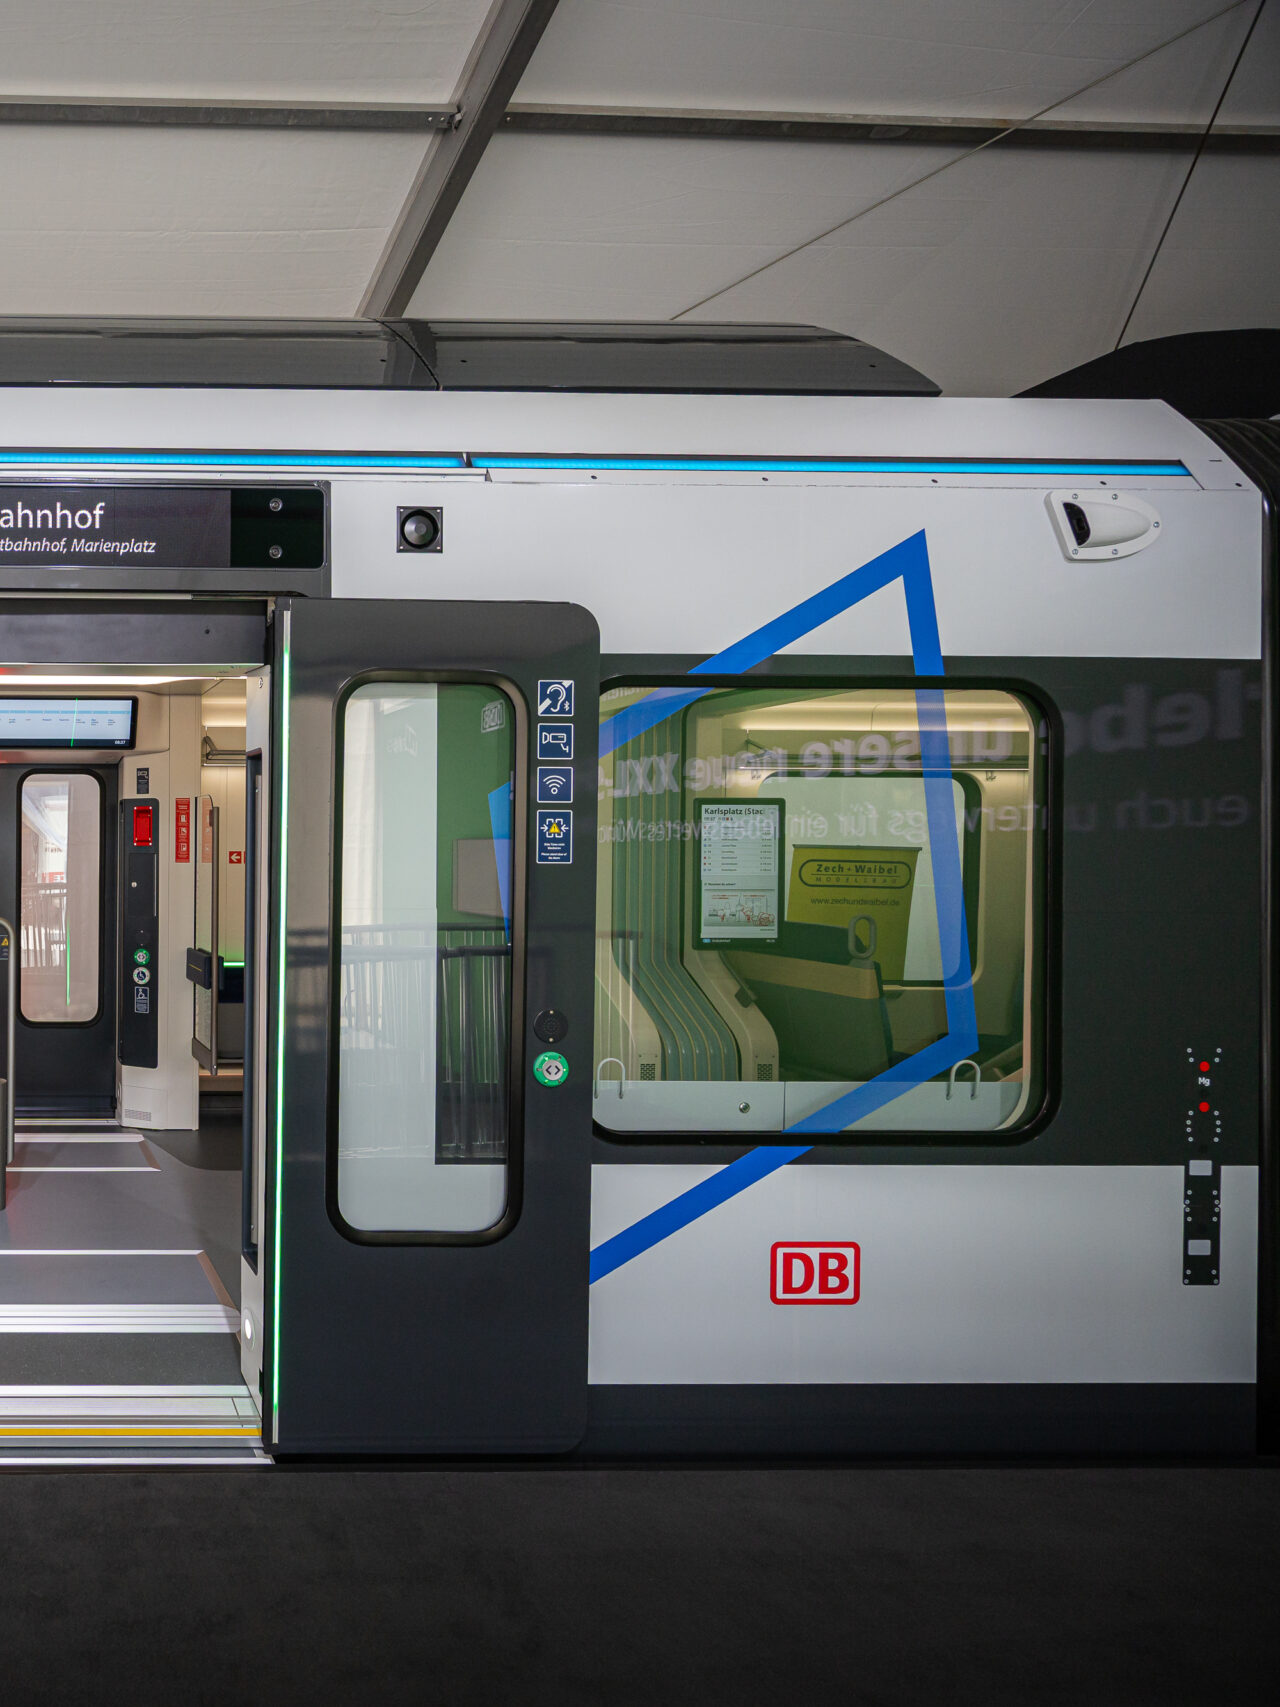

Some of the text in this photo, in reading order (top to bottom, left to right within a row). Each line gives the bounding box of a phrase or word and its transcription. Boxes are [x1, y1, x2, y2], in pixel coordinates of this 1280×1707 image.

[71, 539, 156, 555] Marienplatz
[704, 807, 743, 816] Karlsplatz
[816, 864, 844, 873] Zech
[854, 864, 897, 874] Waibel
[1198, 1077, 1210, 1087] Mg
[782, 1252, 849, 1294] DB
